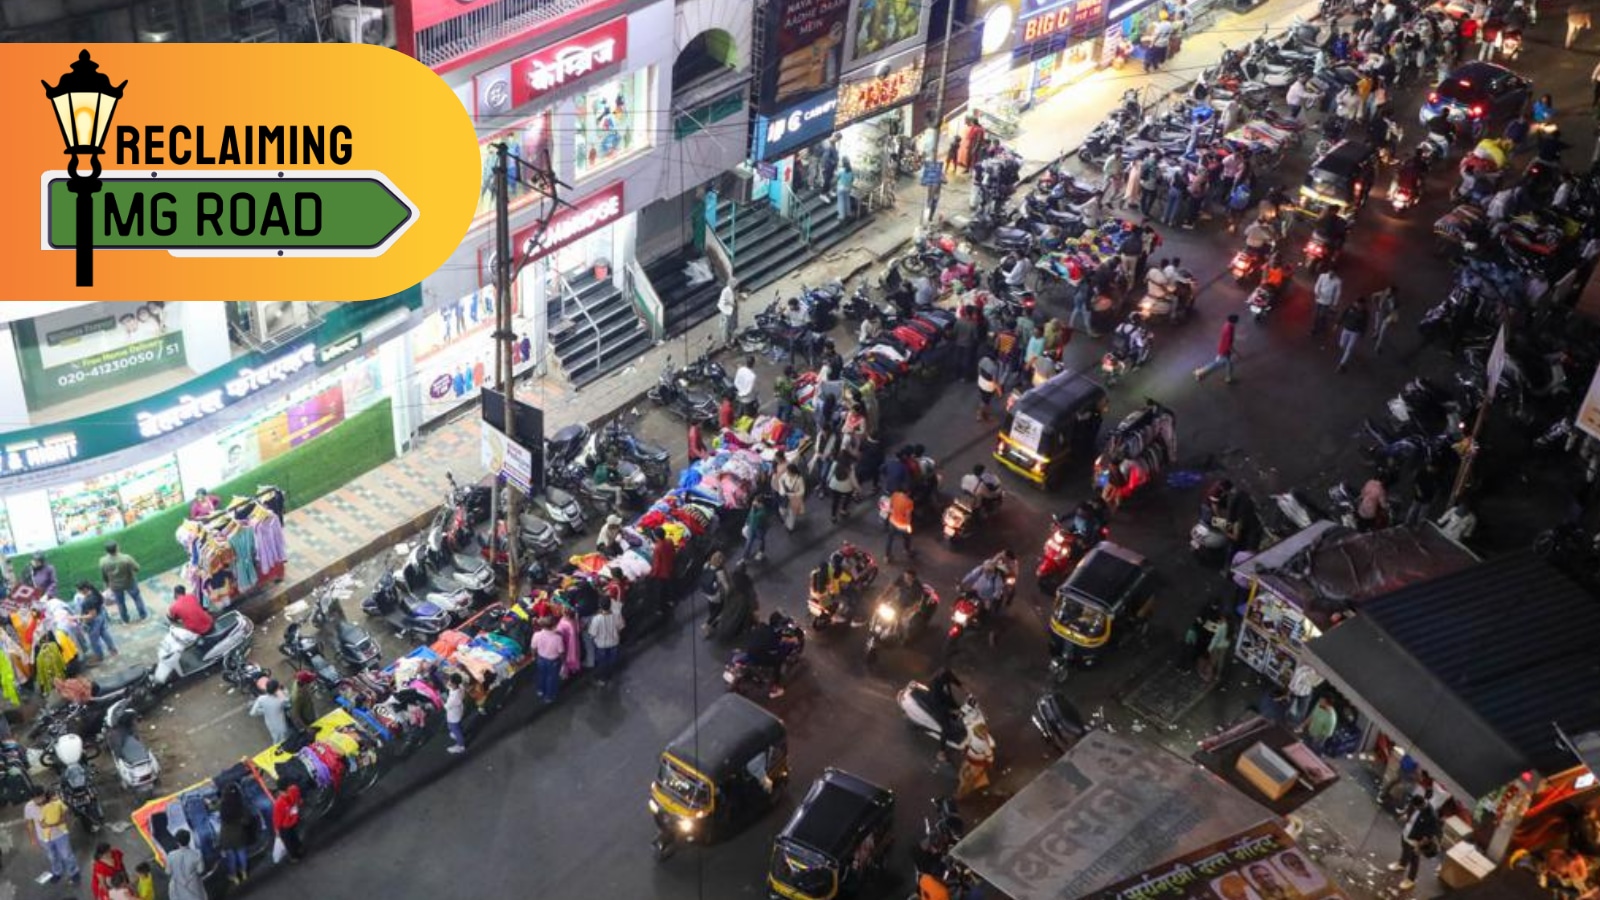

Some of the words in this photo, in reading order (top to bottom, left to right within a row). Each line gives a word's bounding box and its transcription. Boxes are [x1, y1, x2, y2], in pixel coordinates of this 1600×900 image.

[1025, 12, 1056, 41] BIG
[1058, 7, 1070, 28] C
[58, 352, 154, 387] 020-41230050
[166, 343, 179, 355] 51
[137, 389, 224, 438] वेलनेस
